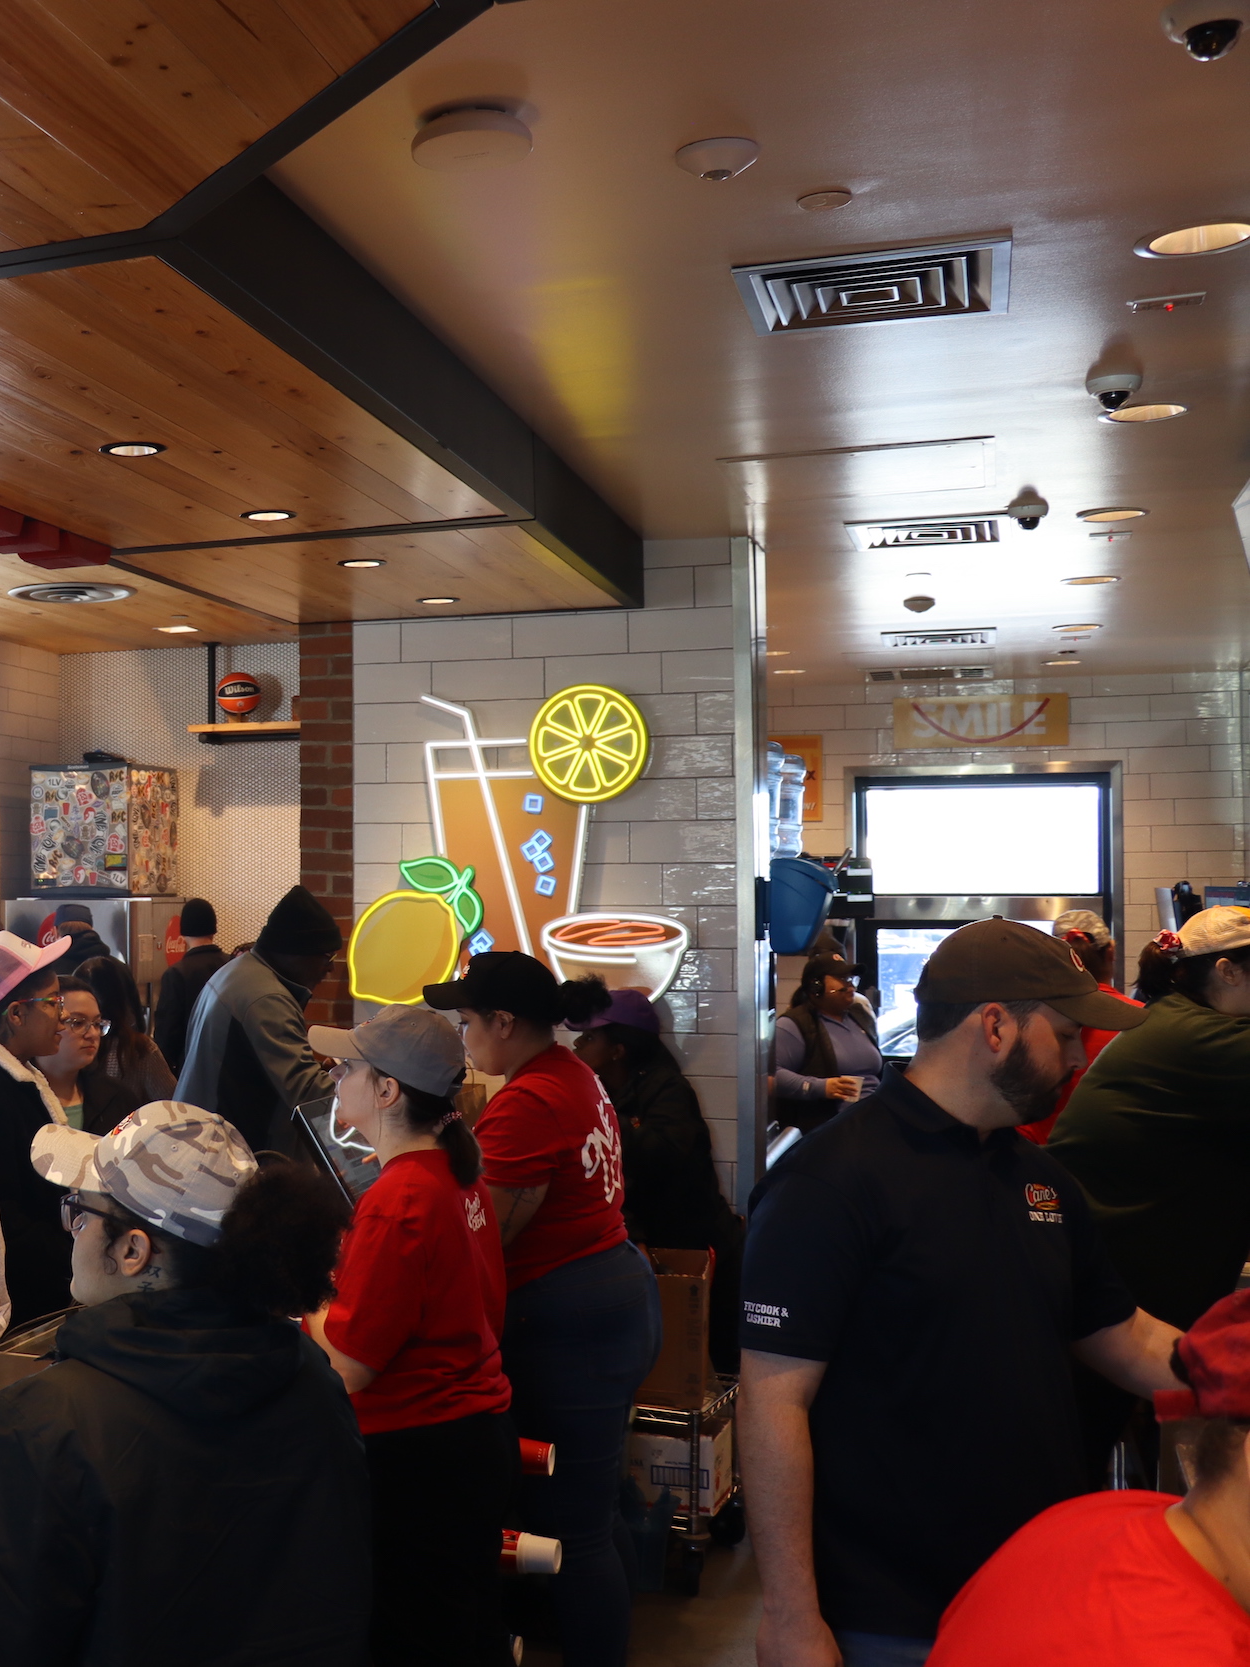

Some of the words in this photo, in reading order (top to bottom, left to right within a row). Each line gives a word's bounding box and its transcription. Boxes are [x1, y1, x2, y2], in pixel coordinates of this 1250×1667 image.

[224, 684, 255, 695] Wilson
[913, 701, 1047, 738] SMILE
[1024, 1183, 1058, 1207] Cane's
[754, 1303, 781, 1317] COOK
[780, 1307, 789, 1318] &
